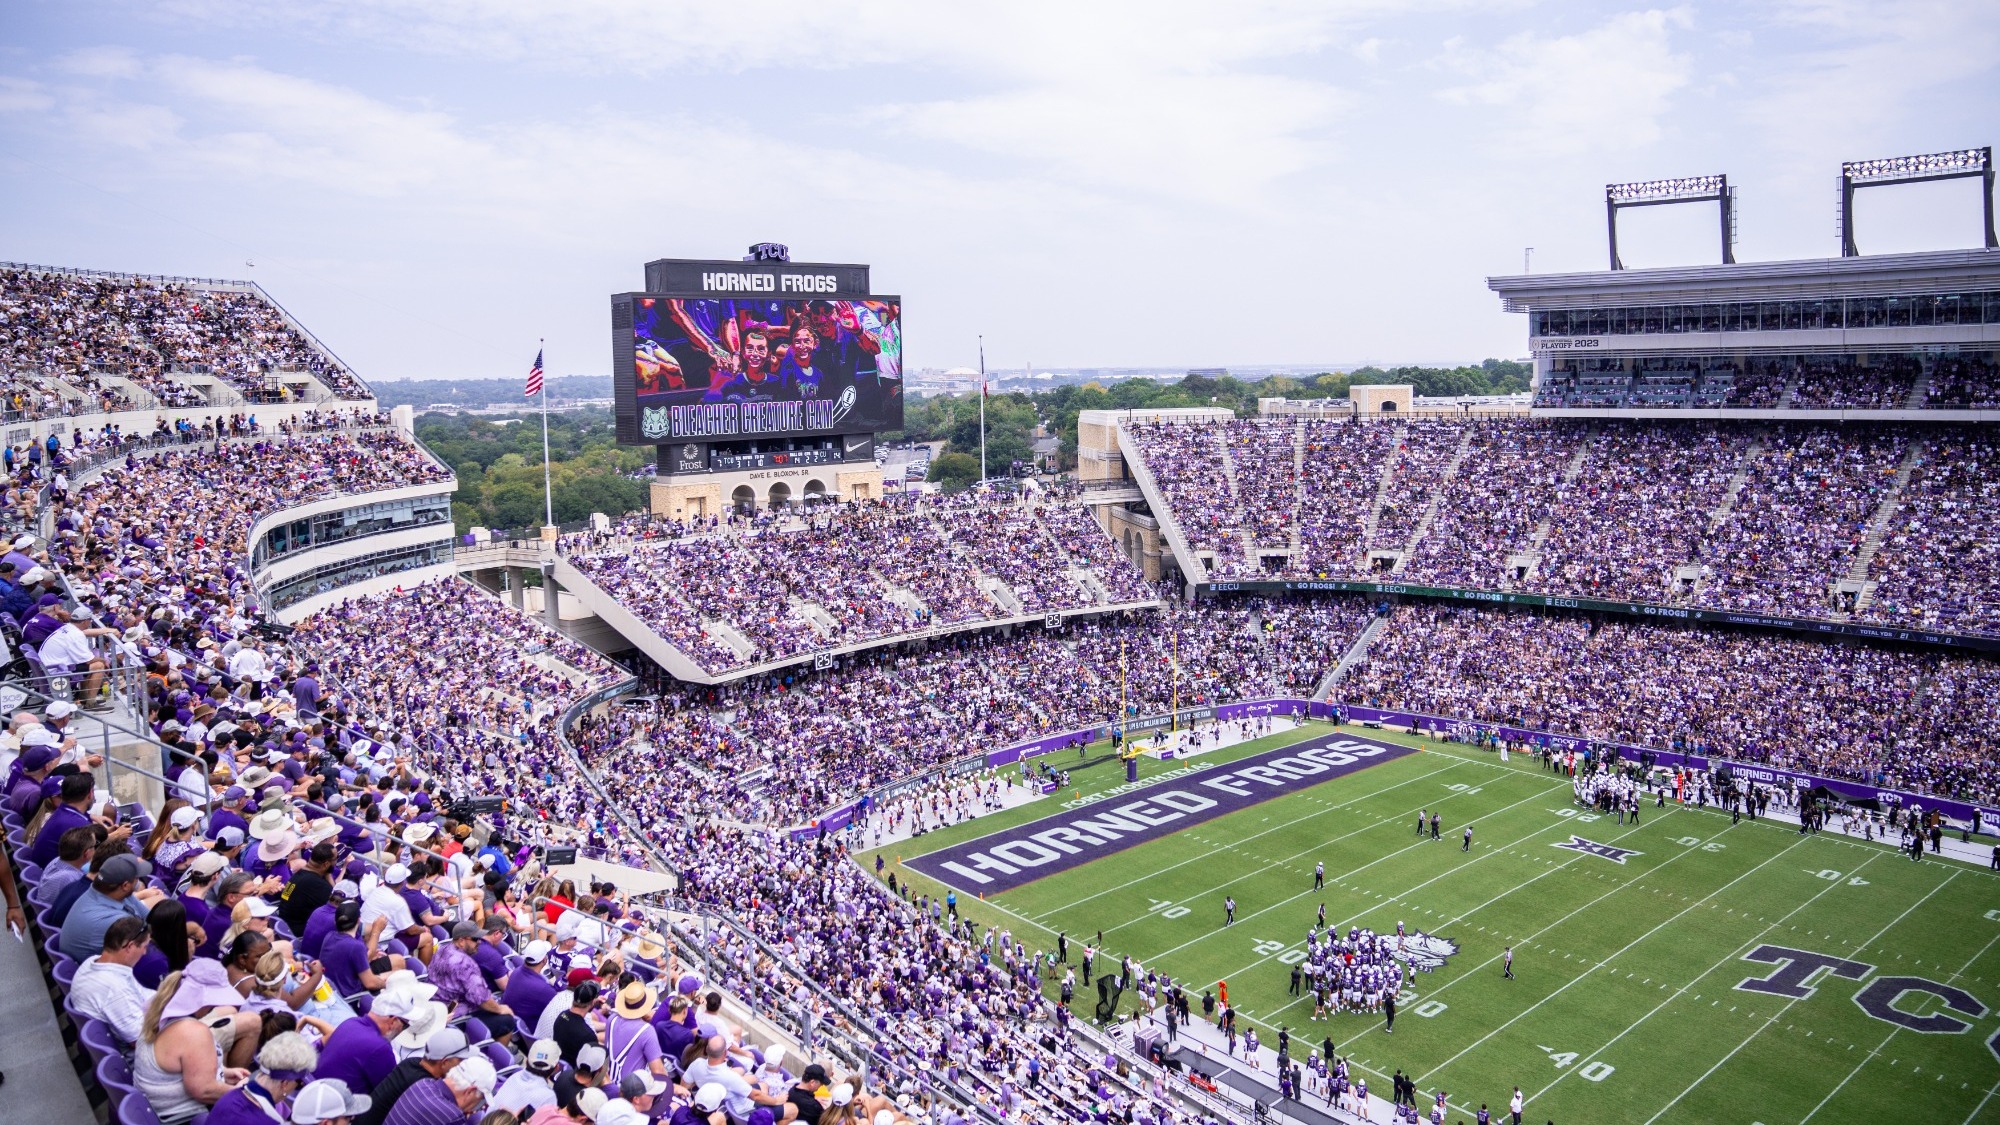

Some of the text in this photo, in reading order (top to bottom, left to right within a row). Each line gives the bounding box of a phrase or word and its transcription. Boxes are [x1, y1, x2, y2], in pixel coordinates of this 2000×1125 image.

[758, 243, 789, 261] TCU
[702, 272, 837, 293] HORNED FROGS
[1574, 339, 1599, 347] 2023
[671, 399, 834, 437] BLEACHER CREATURE CAM
[679, 460, 703, 471] Frost
[749, 471, 764, 480] DAVE
[1218, 583, 1239, 591] EECU
[1385, 584, 1406, 593] EECU
[1464, 591, 1503, 601] GO FROGS!
[1554, 599, 1578, 608] EECU
[1644, 607, 1688, 618] GO FROGS!
[1048, 615, 1060, 626] 25
[817, 655, 830, 667] 25
[1732, 766, 1773, 781] HORNED
[1060, 792, 1106, 809] FORT
[1166, 761, 1215, 778] TEXAS
[940, 740, 1387, 884] HORNED FROGS
[1148, 900, 1192, 919] 10
[1251, 940, 1309, 964] 20
[1731, 943, 2000, 1064] TC
[1548, 1051, 1616, 1082] 40
